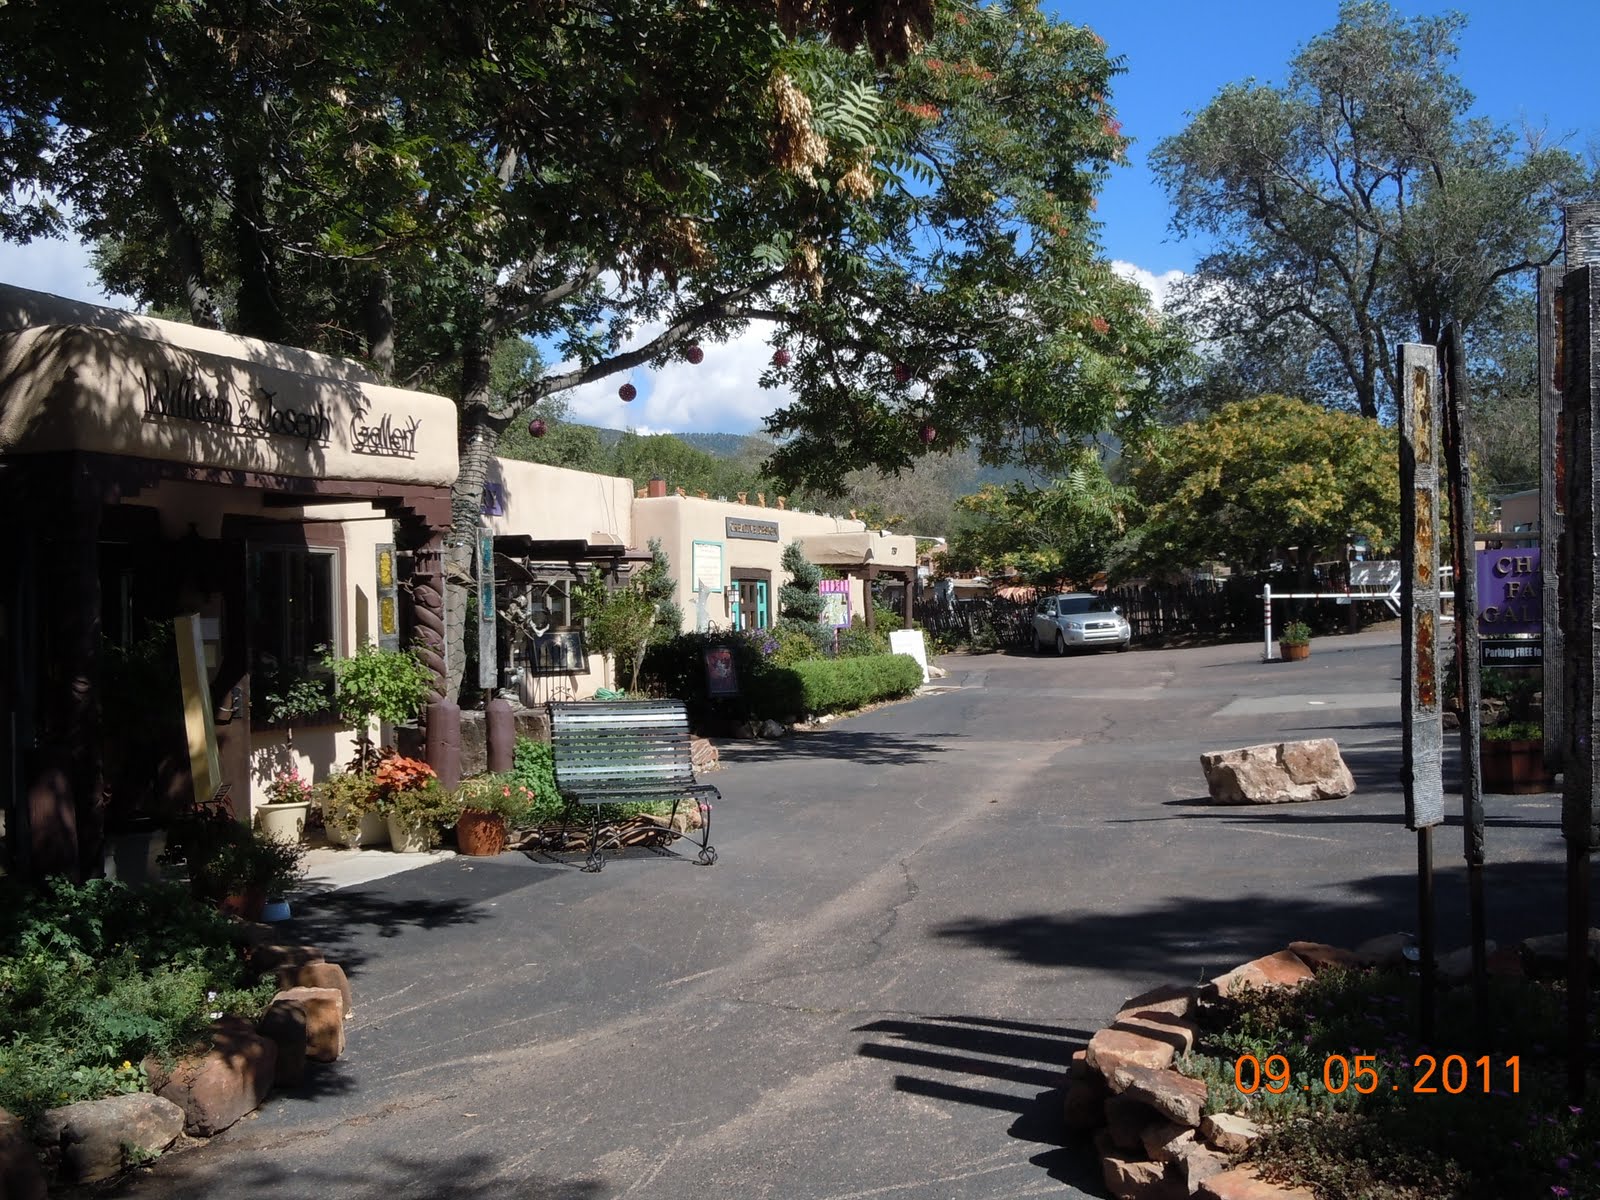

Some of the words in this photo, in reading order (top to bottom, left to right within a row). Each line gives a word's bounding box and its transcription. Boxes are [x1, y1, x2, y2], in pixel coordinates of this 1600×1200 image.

[259, 388, 331, 450] Joseph
[1496, 556, 1539, 574] CH
[1482, 605, 1541, 623] GAL
[1484, 647, 1515, 659] Parking
[1516, 646, 1533, 657] FREE
